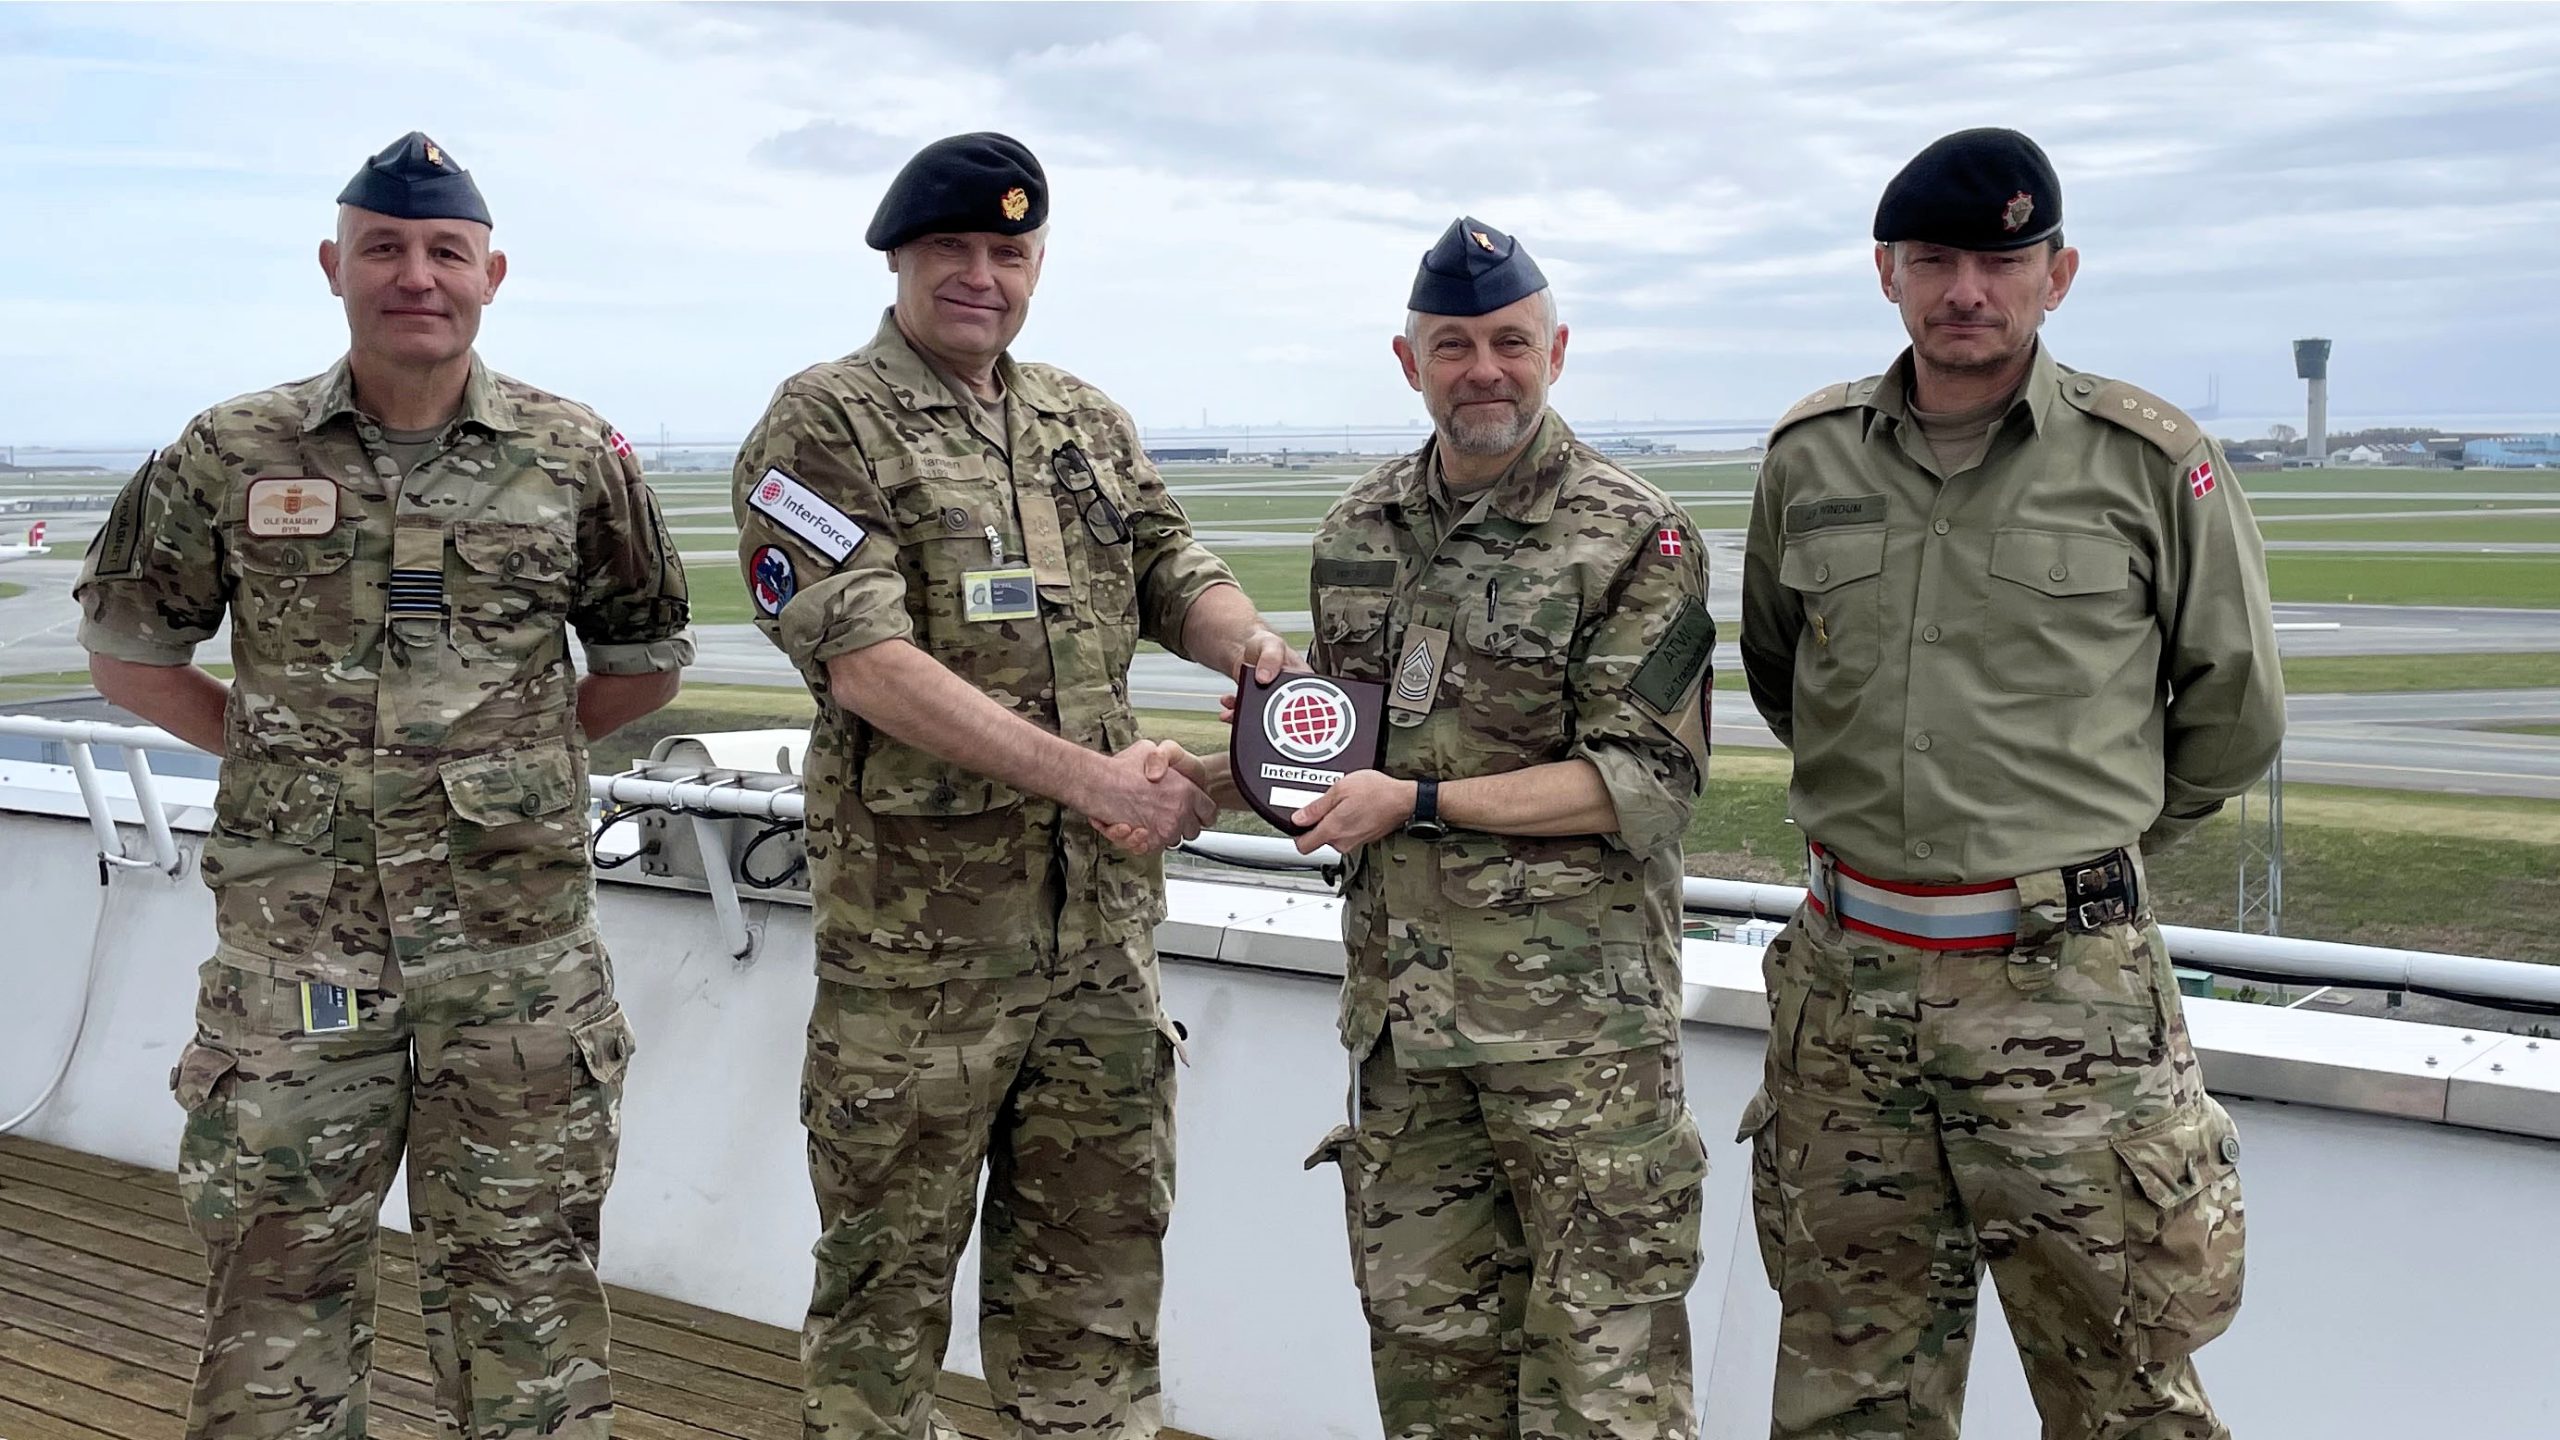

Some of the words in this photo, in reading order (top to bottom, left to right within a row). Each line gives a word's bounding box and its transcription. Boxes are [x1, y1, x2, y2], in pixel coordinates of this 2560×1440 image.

[263, 517, 280, 526] OLE
[282, 517, 319, 526] RAMSBY
[782, 495, 853, 551] InterForce
[1662, 623, 1692, 667] ATW
[1663, 685, 1676, 701] Air
[1263, 765, 1341, 783] InterForce
